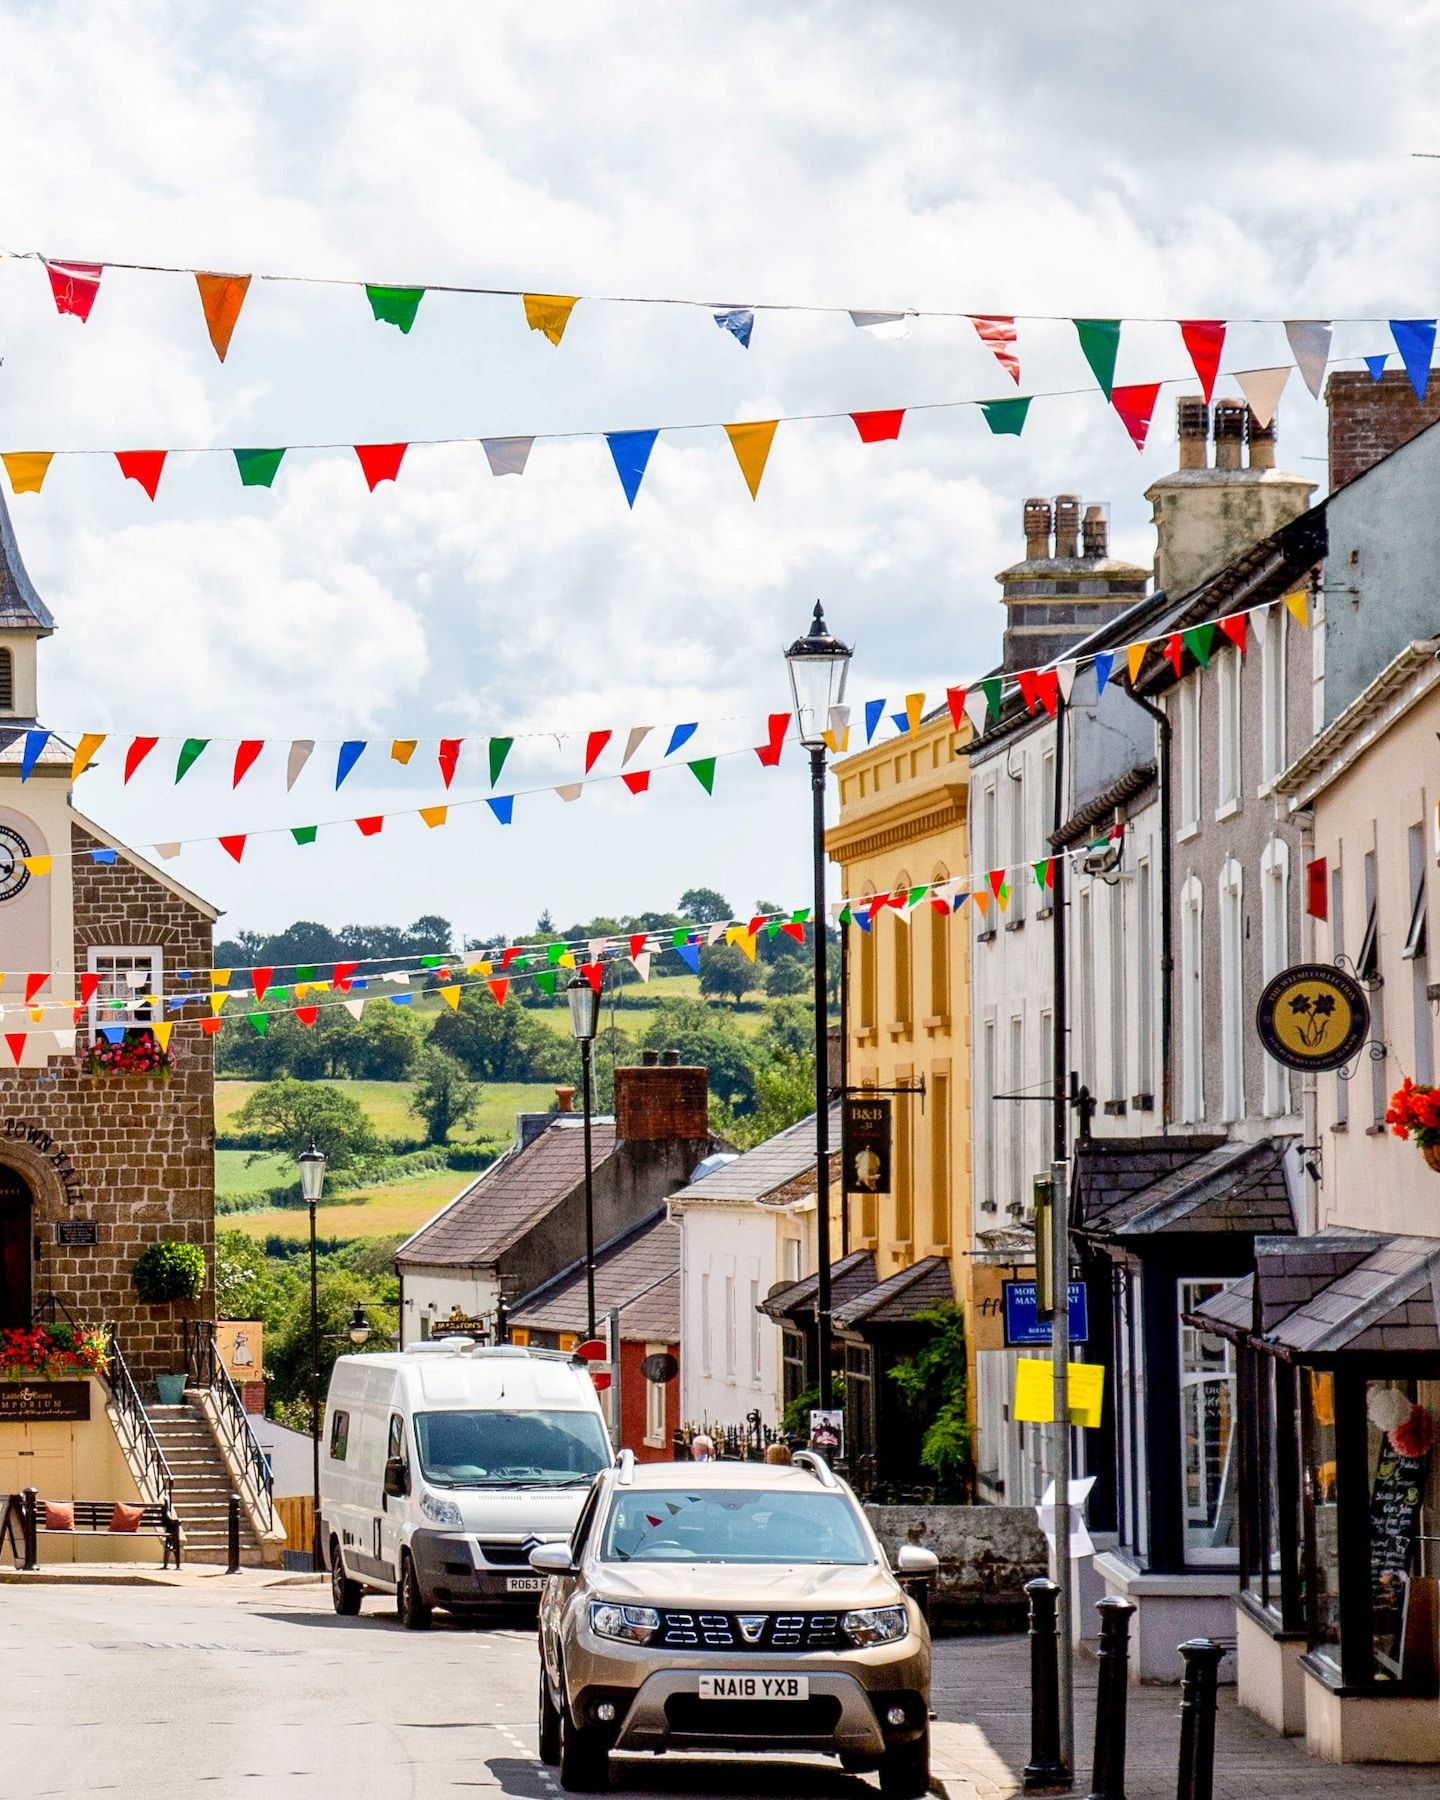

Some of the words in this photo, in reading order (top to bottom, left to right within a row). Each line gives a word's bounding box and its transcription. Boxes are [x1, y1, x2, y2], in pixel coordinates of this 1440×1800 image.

[852, 1108, 883, 1120] B&B
[4, 1118, 55, 1153] TOWN
[50, 1149, 83, 1206] HALL
[713, 1678, 756, 1696] NA18
[762, 1679, 798, 1696] YXB
